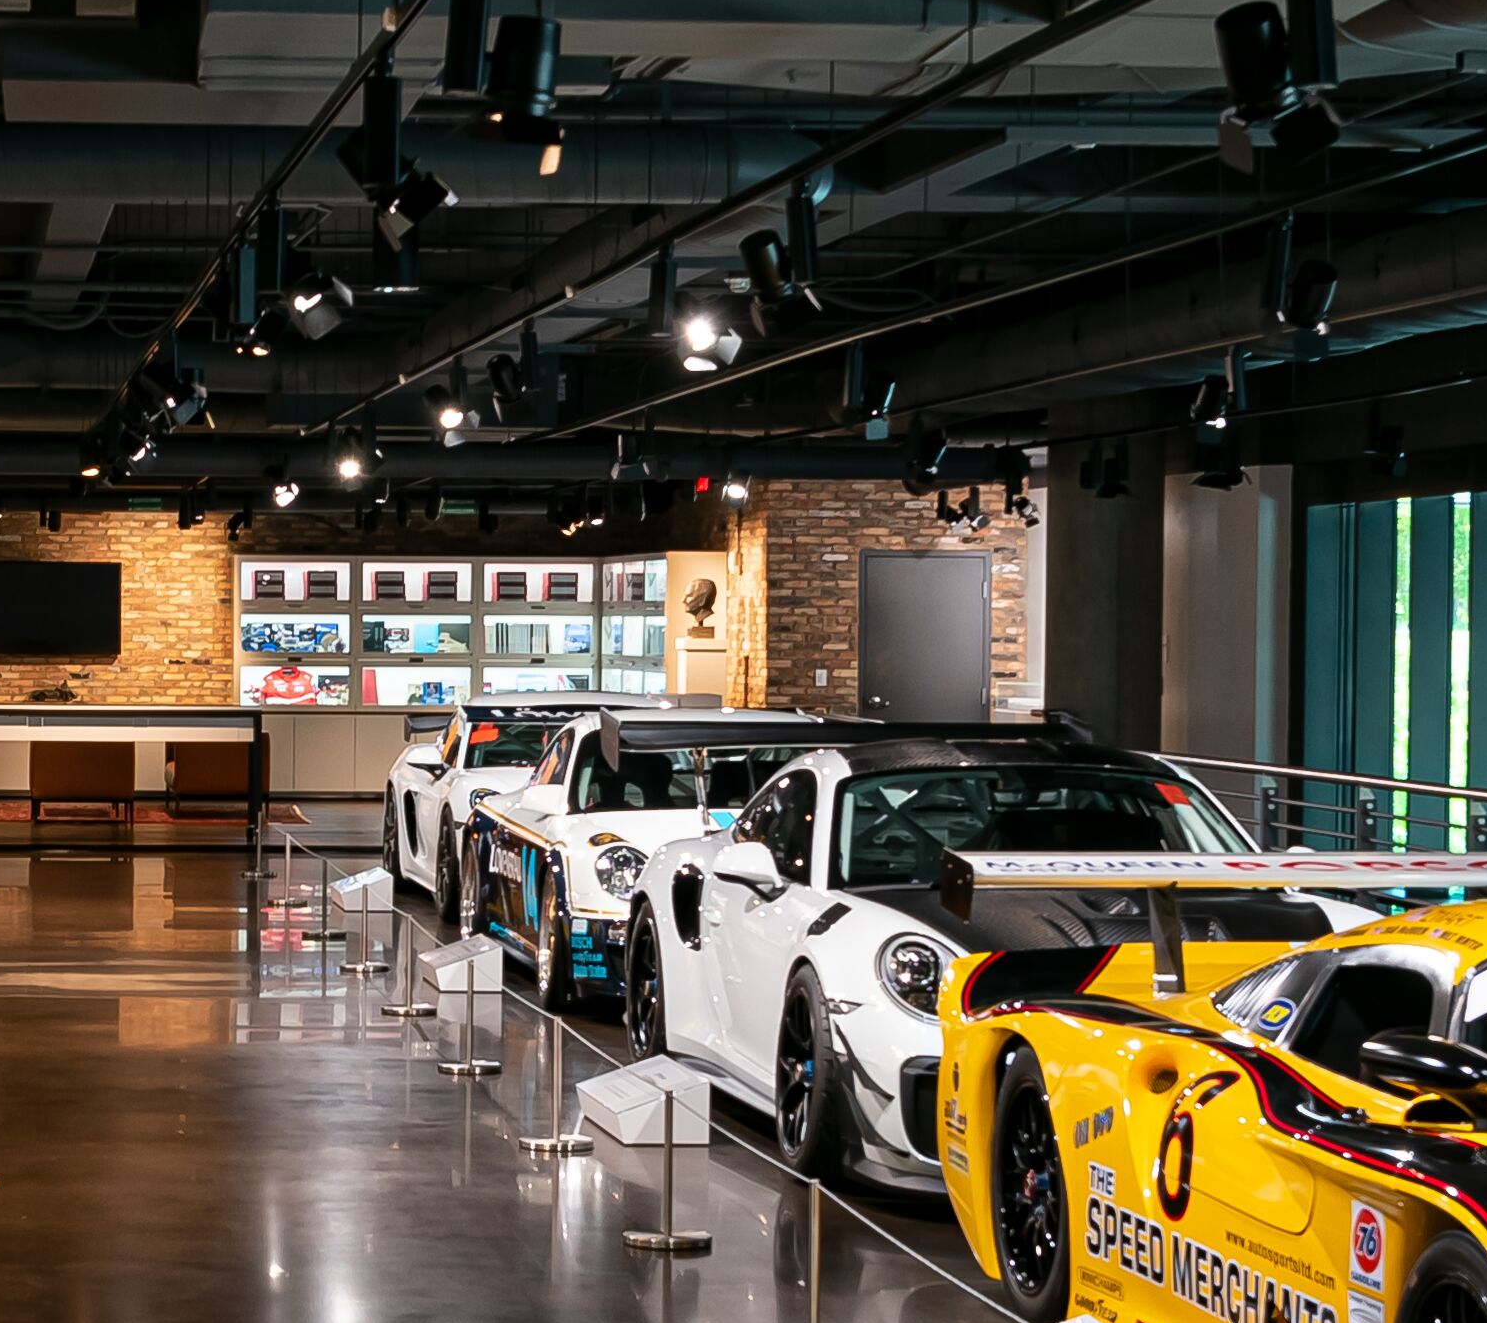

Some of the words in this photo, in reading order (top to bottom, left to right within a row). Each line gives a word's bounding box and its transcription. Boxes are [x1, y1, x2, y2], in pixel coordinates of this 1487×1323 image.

[1157, 1070, 1241, 1221] 6
[1089, 1164, 1114, 1195] THE
[1085, 1196, 1165, 1284] SPEED
[1356, 1225, 1378, 1257] 76
[1075, 1293, 1118, 1323] GOODYEAR
